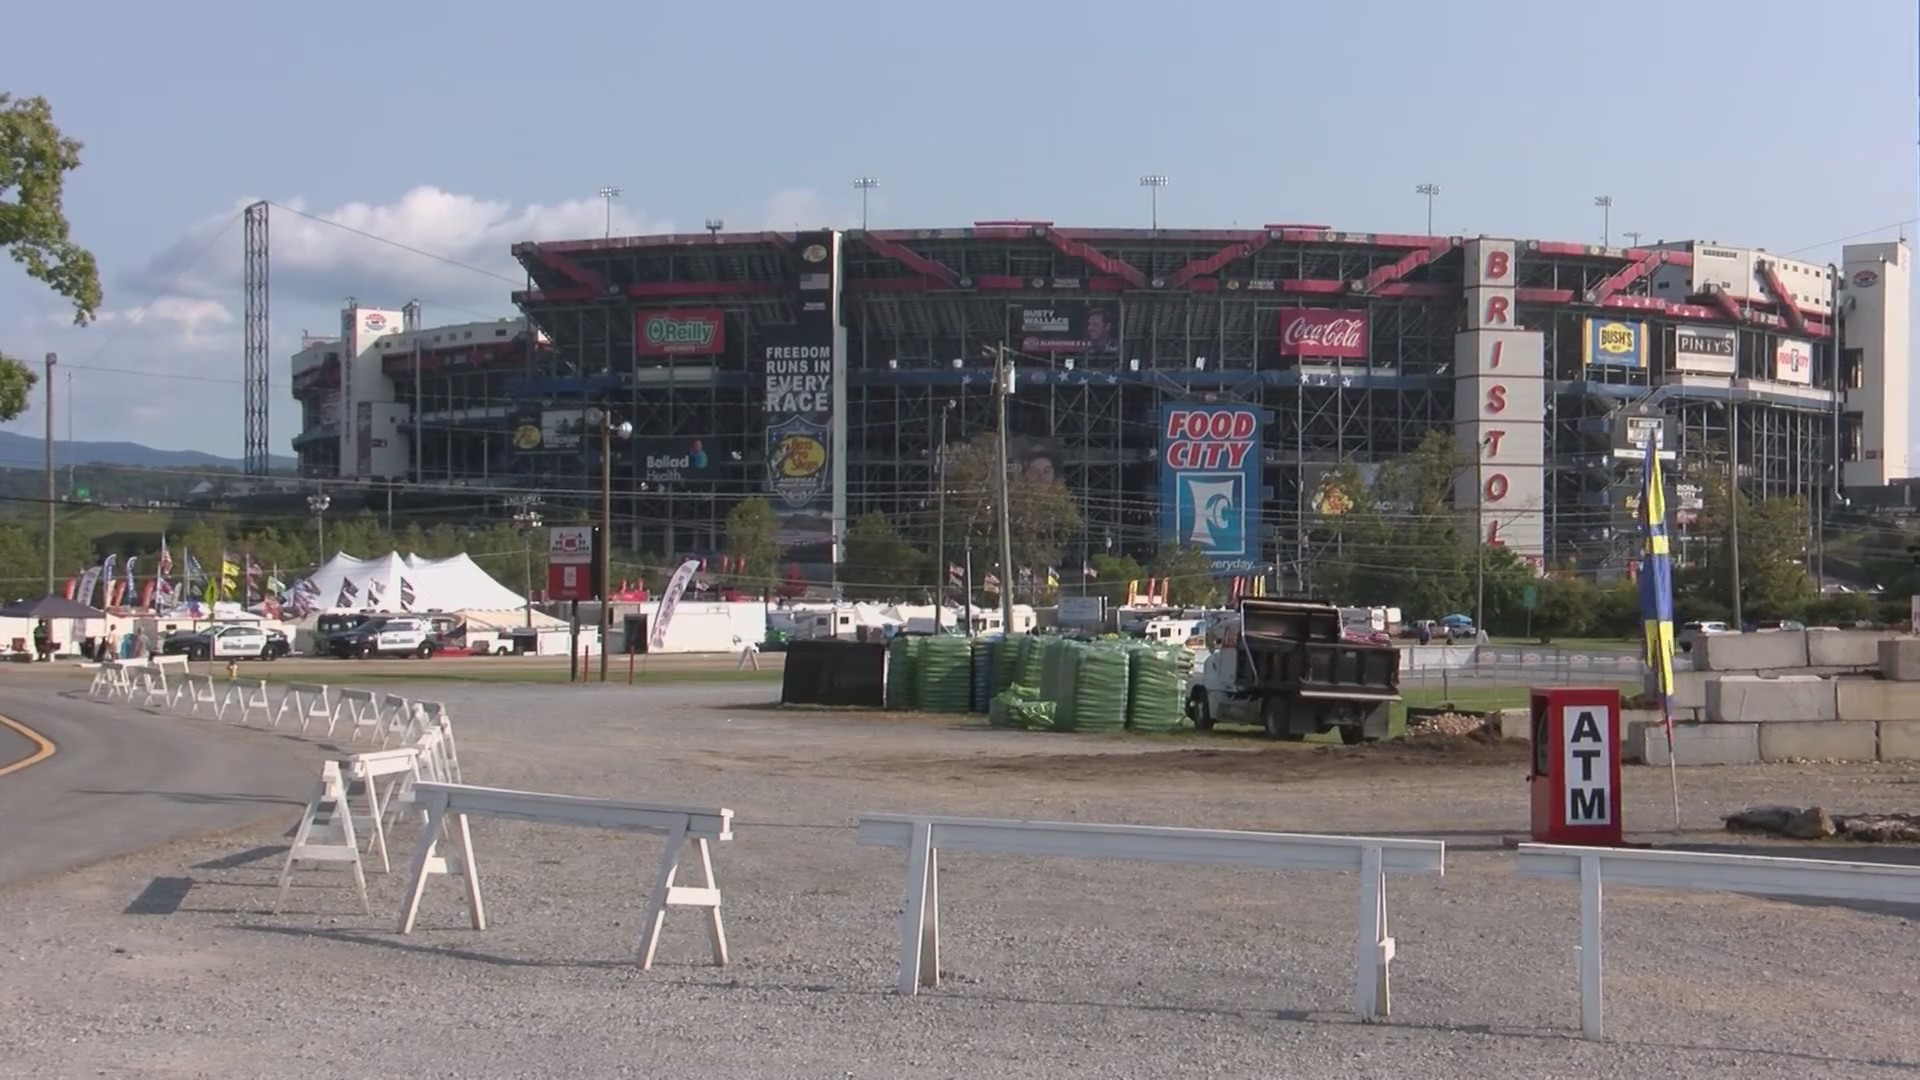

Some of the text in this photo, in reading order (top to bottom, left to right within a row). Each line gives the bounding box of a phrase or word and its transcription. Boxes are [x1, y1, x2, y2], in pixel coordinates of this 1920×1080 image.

[1023, 309, 1055, 318] RUSTY
[1023, 316, 1069, 325] WALLACE
[646, 318, 713, 344] O'Reilly
[1285, 317, 1364, 348] Coca-Cola
[1602, 329, 1633, 347] BUSH'S
[766, 346, 830, 359] FREEDOM
[1681, 337, 1731, 353] PINTY'S
[766, 360, 830, 374] RUNS IN
[766, 375, 830, 391] EVERY
[766, 392, 828, 412] RACE
[1486, 250, 1509, 548] BRISTOL
[1167, 410, 1256, 440] FOOD
[646, 455, 689, 468] Ballad
[1167, 440, 1255, 469] CITY
[646, 469, 681, 480] Health
[1211, 559, 1255, 571] veryday.
[1570, 711, 1605, 820] ATM
